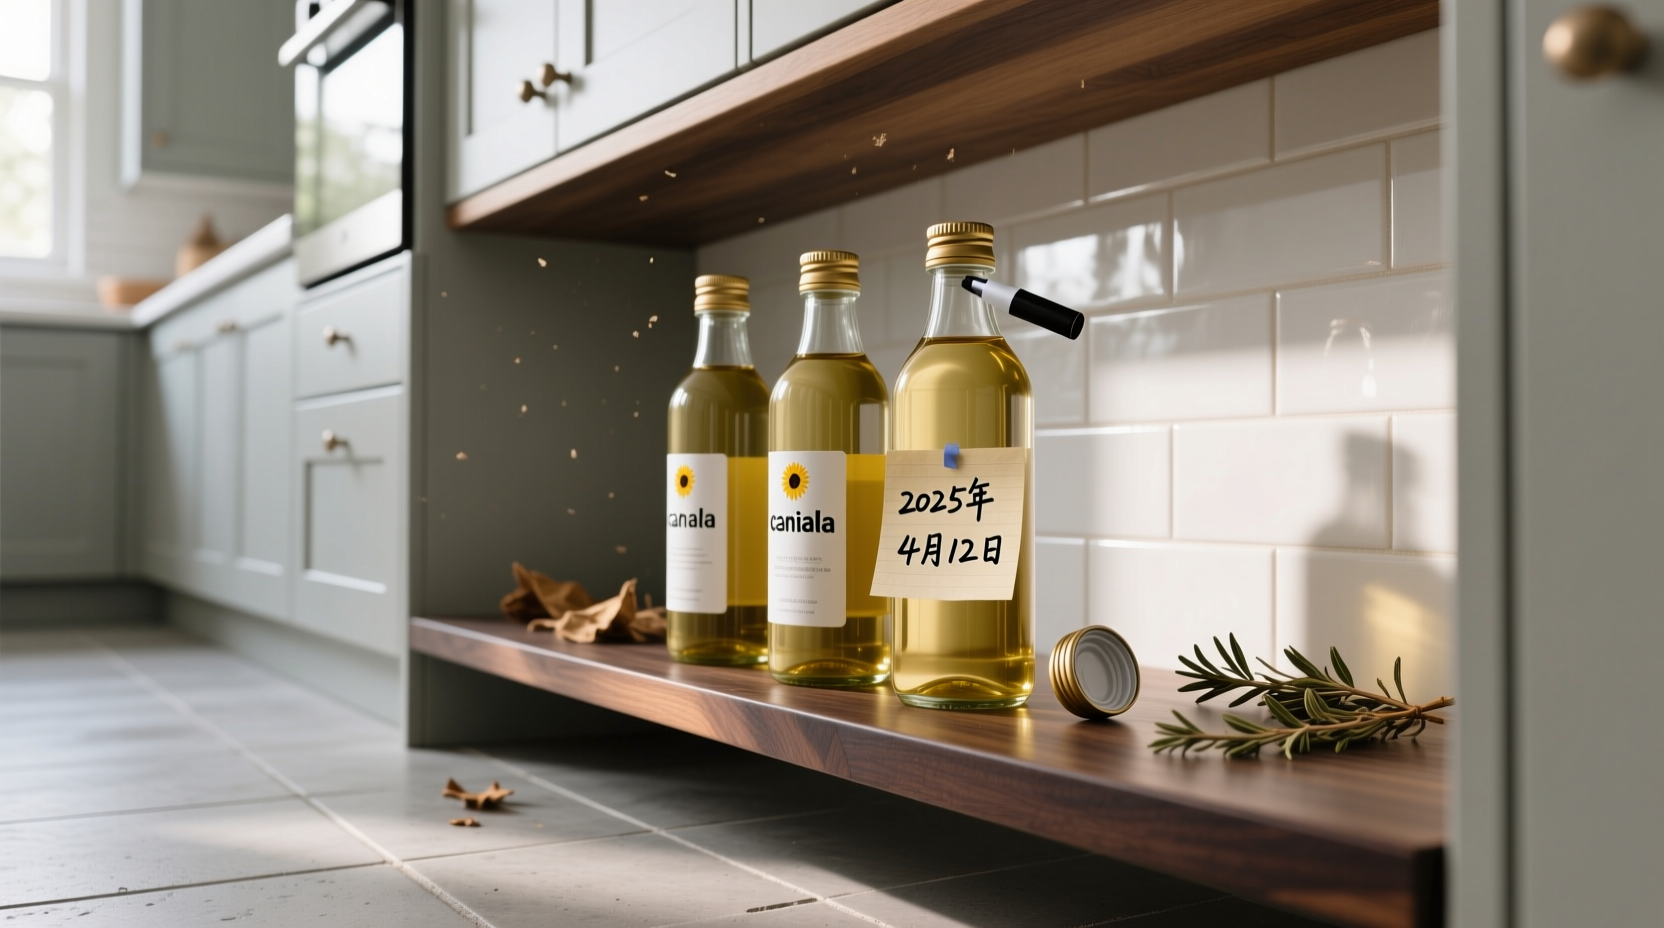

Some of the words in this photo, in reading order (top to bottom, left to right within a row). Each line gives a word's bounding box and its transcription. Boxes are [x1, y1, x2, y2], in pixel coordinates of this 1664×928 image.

[898, 477, 994, 522] 2025年
[770, 509, 835, 533] caniala
[897, 532, 1001, 567] 4月12日
